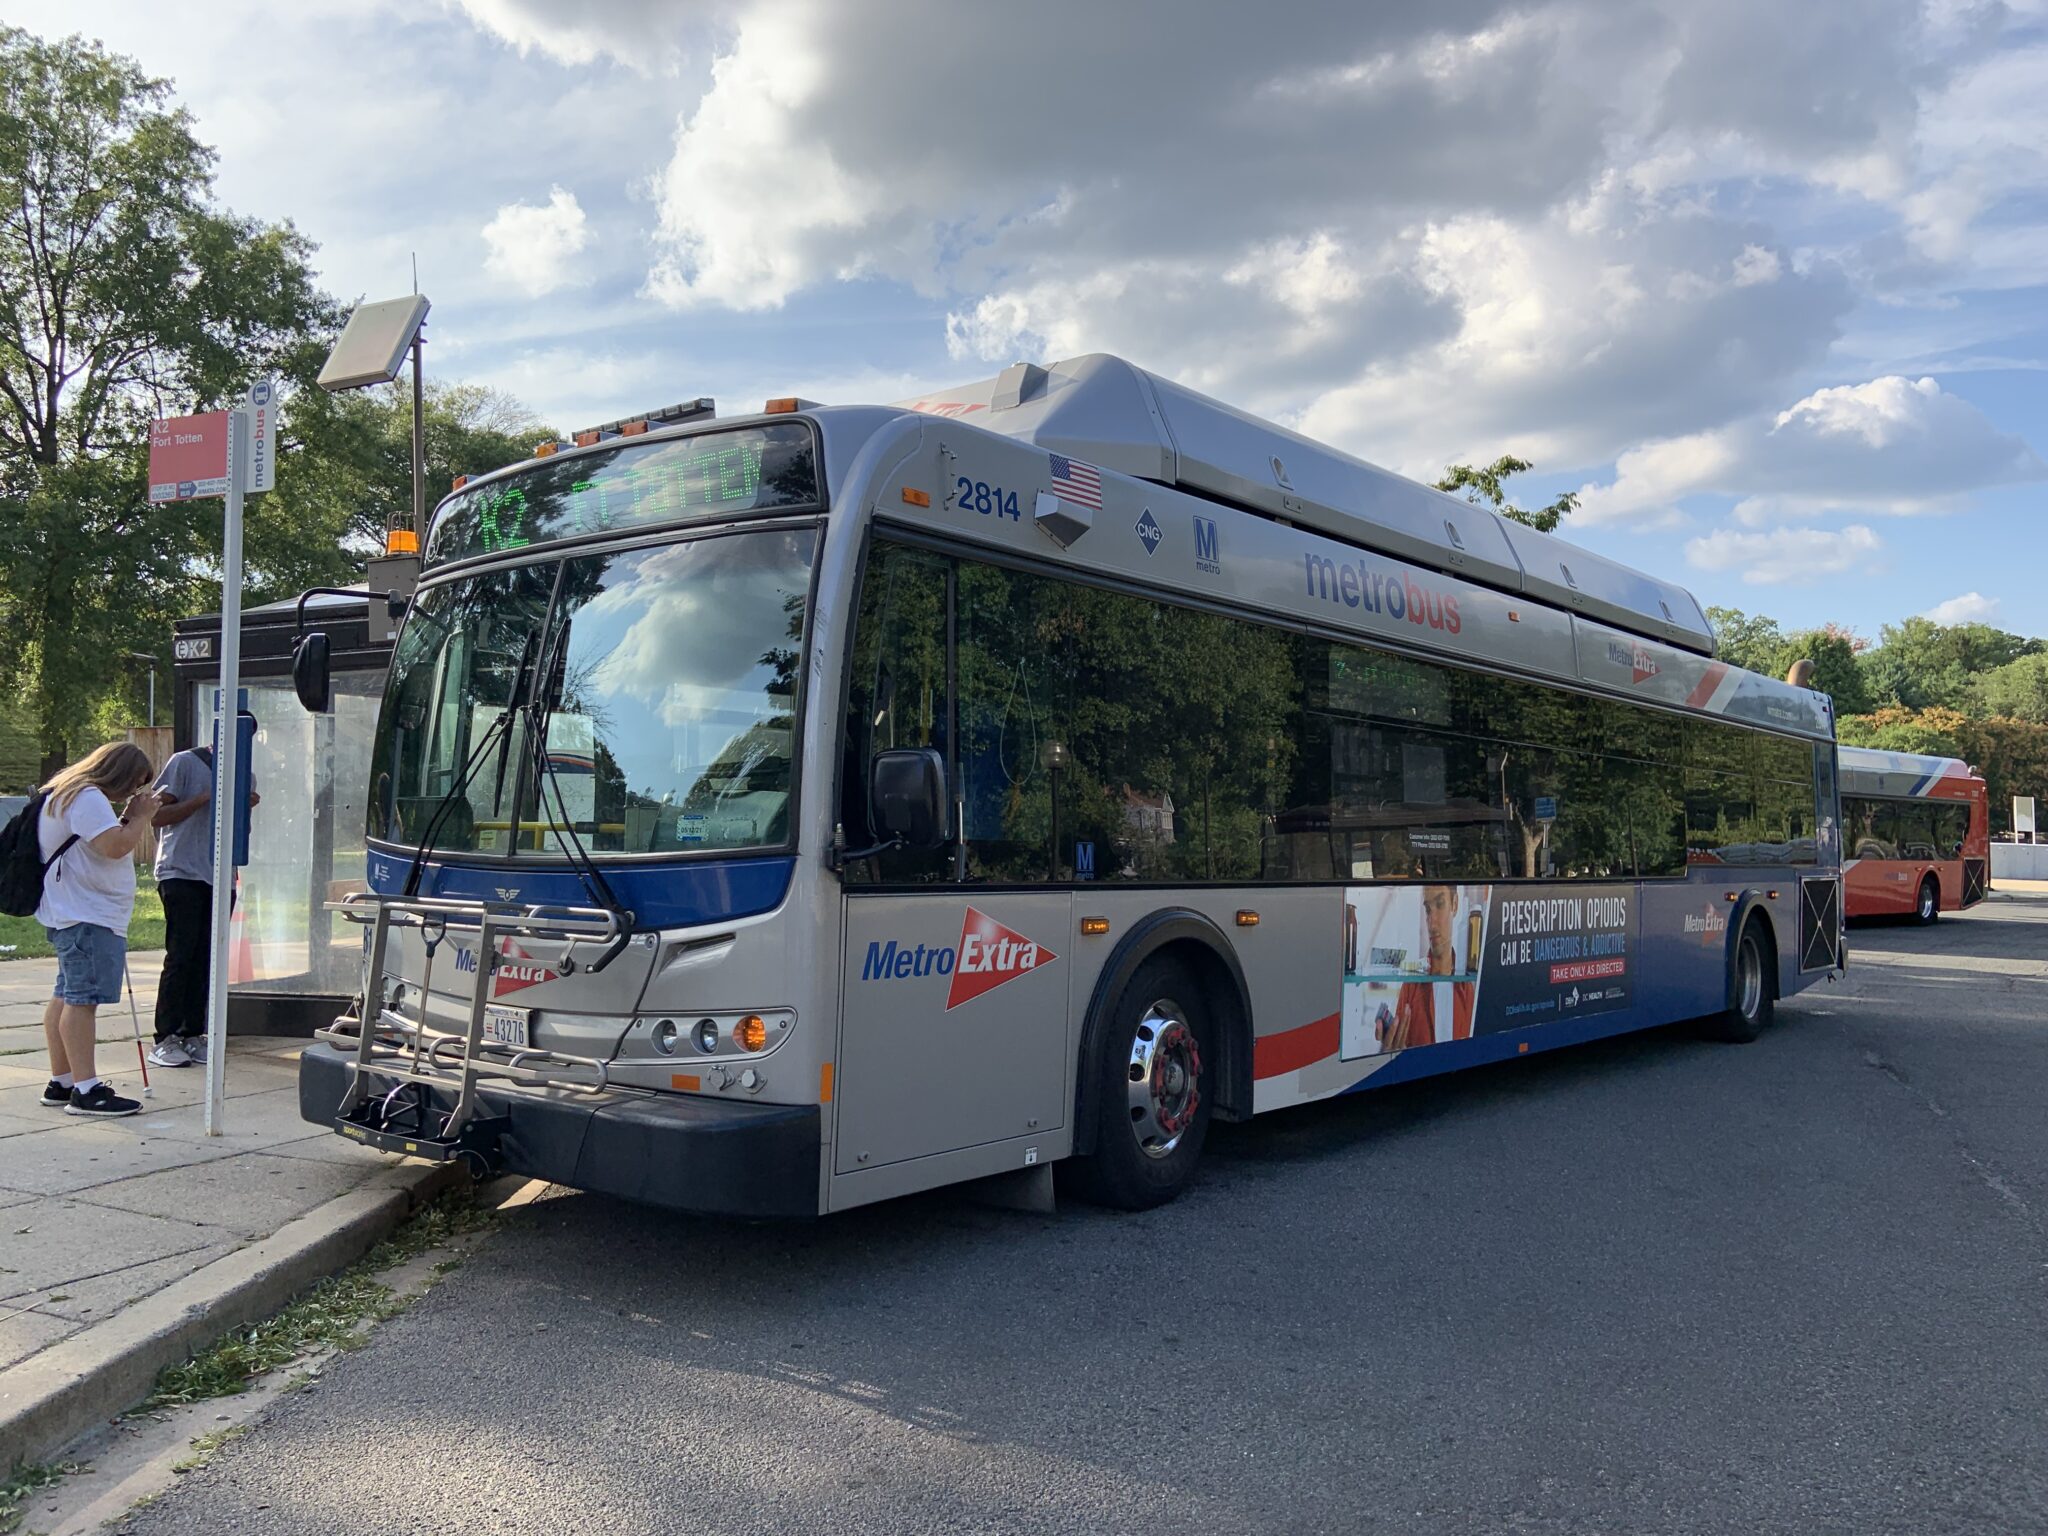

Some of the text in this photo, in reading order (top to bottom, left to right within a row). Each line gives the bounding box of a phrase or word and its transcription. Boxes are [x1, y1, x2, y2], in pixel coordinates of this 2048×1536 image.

[153, 421, 169, 434] K2
[153, 433, 203, 448] Fort Totten
[254, 409, 265, 488] metrobus
[957, 476, 1021, 522] 2814
[480, 488, 530, 553] K2
[1136, 522, 1161, 541] CNG
[1195, 520, 1219, 561] M
[1196, 561, 1221, 576] metro
[1304, 550, 1461, 635] metrobus
[190, 640, 209, 657] K2
[1502, 897, 1626, 935] PRESCRIPTION OPIOIDS
[1500, 940, 1517, 966] CAN
[1520, 939, 1531, 964] BE
[1534, 936, 1580, 962] DANGEROUS
[1590, 932, 1625, 956] ADDICTIVE
[1553, 961, 1623, 980] TAKE ONLY AS DIRECTED
[494, 1017, 524, 1044] 43276
